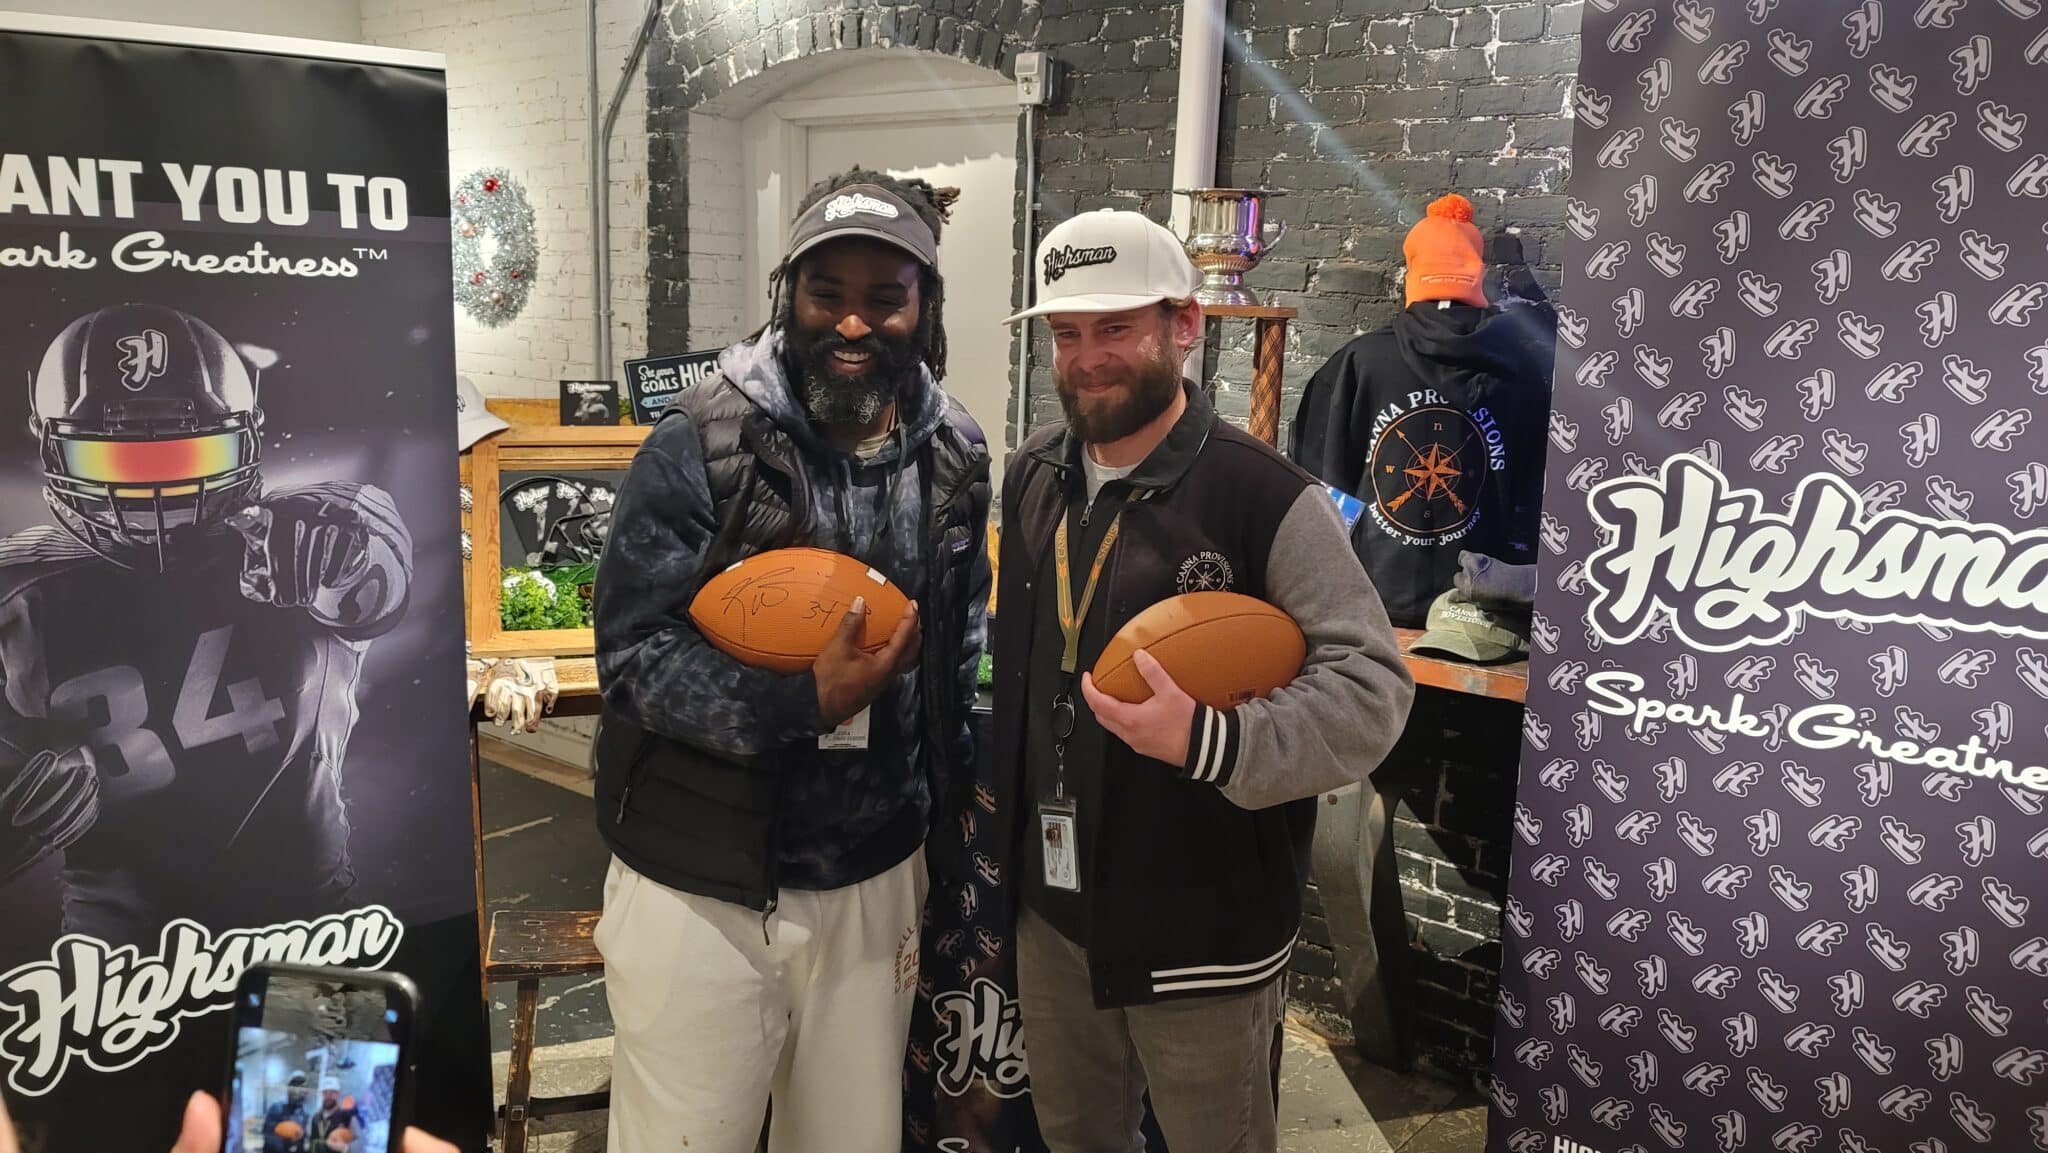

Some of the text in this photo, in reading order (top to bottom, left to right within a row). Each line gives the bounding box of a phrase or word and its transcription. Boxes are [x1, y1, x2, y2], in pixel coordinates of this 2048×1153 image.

[161, 162, 309, 226] YOU
[327, 173, 408, 231] TO
[1043, 244, 1117, 286] Highsman
[641, 377, 679, 393] GOALS
[1369, 501, 1402, 529] better
[1402, 534, 1436, 546] your
[1176, 554, 1199, 584] CANNA
[1585, 671, 1769, 734] Spark
[6, 910, 395, 1080] Highsman
